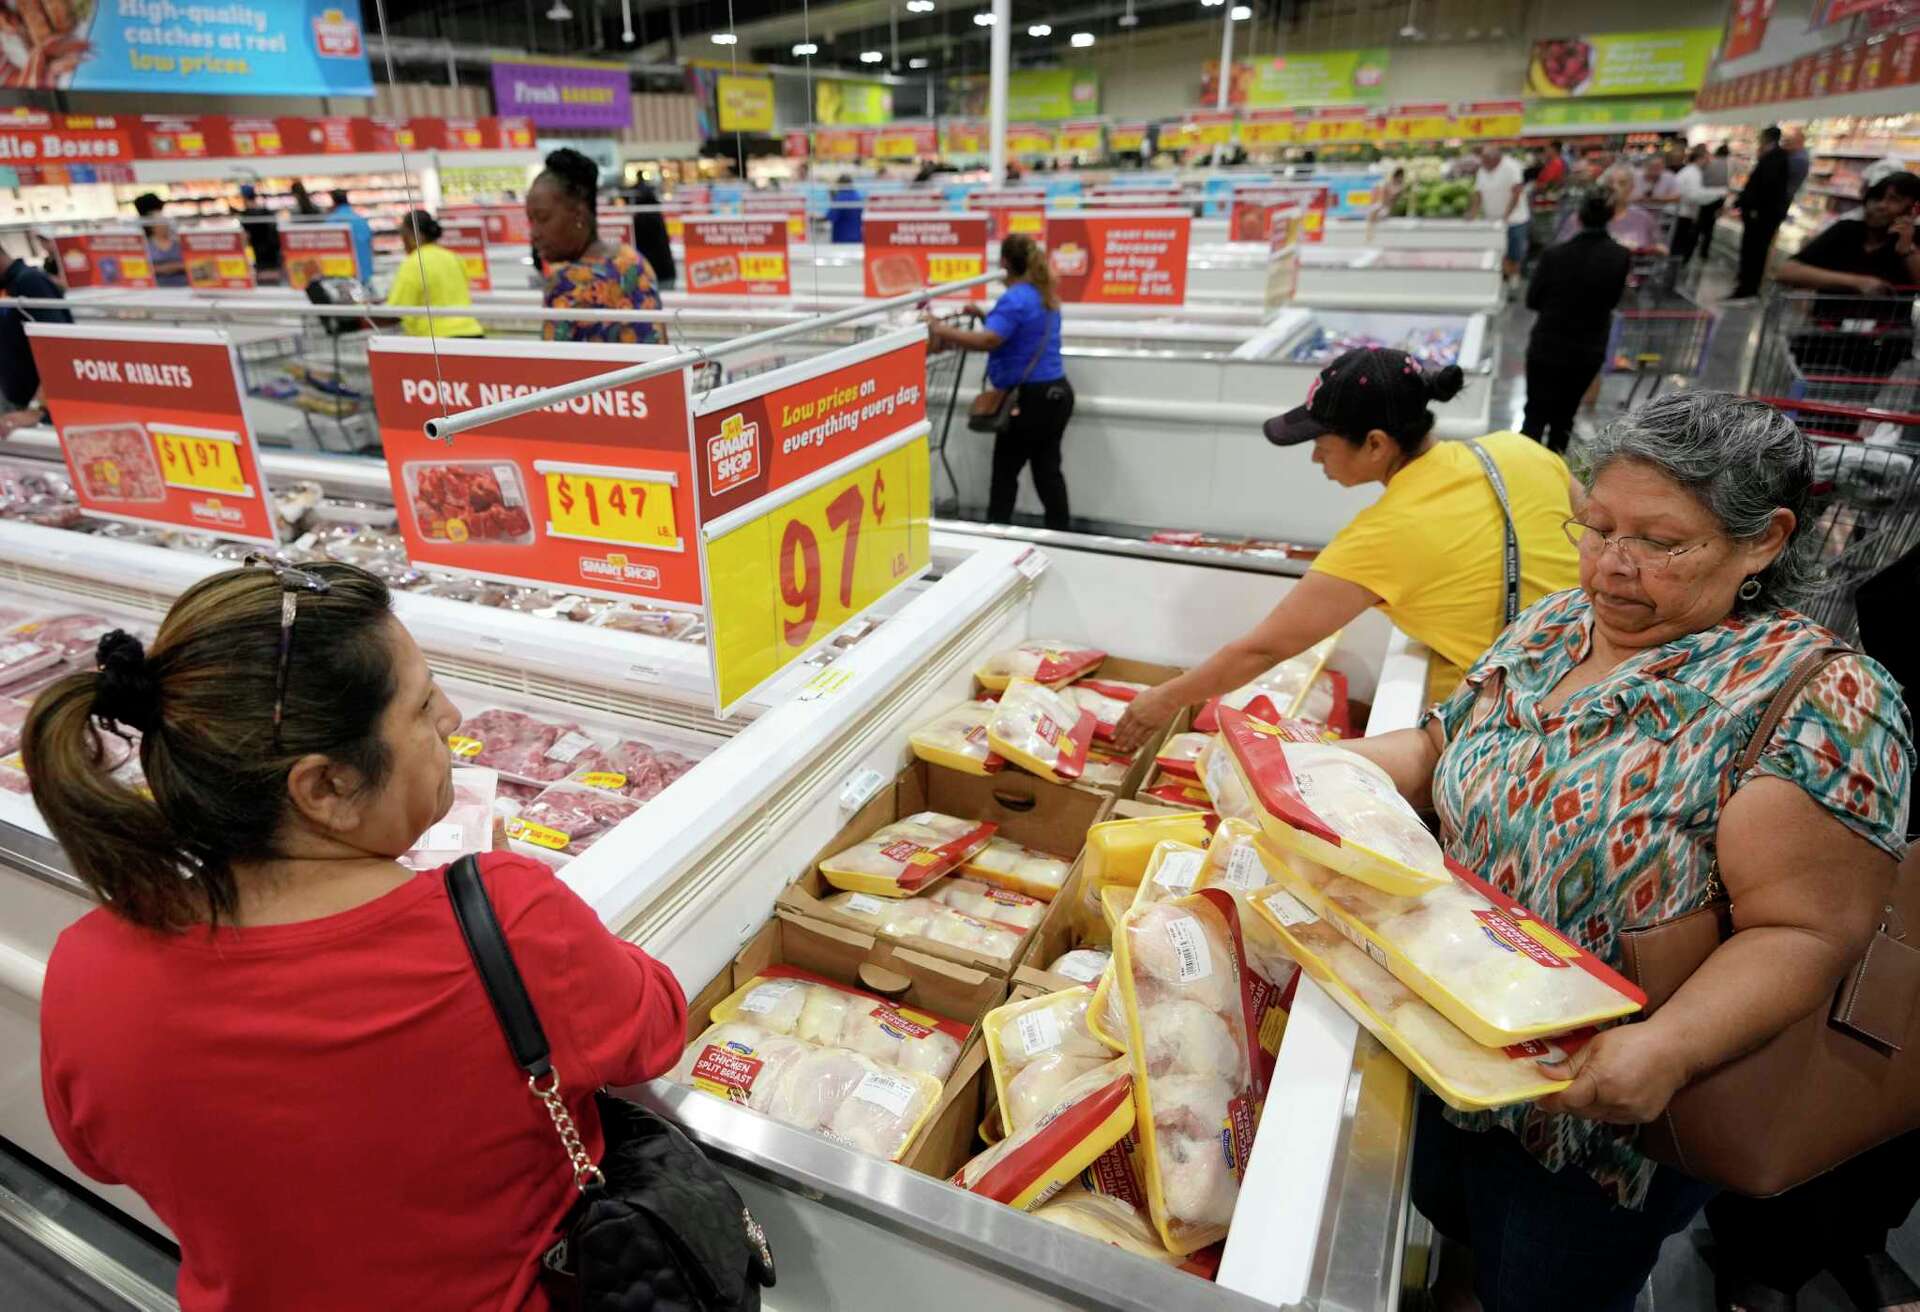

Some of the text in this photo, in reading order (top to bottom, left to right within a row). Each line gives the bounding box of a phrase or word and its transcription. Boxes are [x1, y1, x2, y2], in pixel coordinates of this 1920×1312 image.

[124, 26, 214, 47] catches
[218, 31, 240, 49] at
[43, 134, 118, 158] Boxes
[72, 358, 192, 388] PORK RIBLETS
[401, 378, 472, 406] PORK
[782, 378, 876, 428] Low prices on
[782, 385, 920, 454] everything every day.
[711, 427, 756, 463] SMART
[717, 450, 752, 480] SHOP
[582, 560, 657, 582] SMART SHOP
[696, 1059, 753, 1085] SPLIT BREAST
[708, 1053, 752, 1074] CHICKEN
[1100, 1152, 1117, 1197] HICKE
